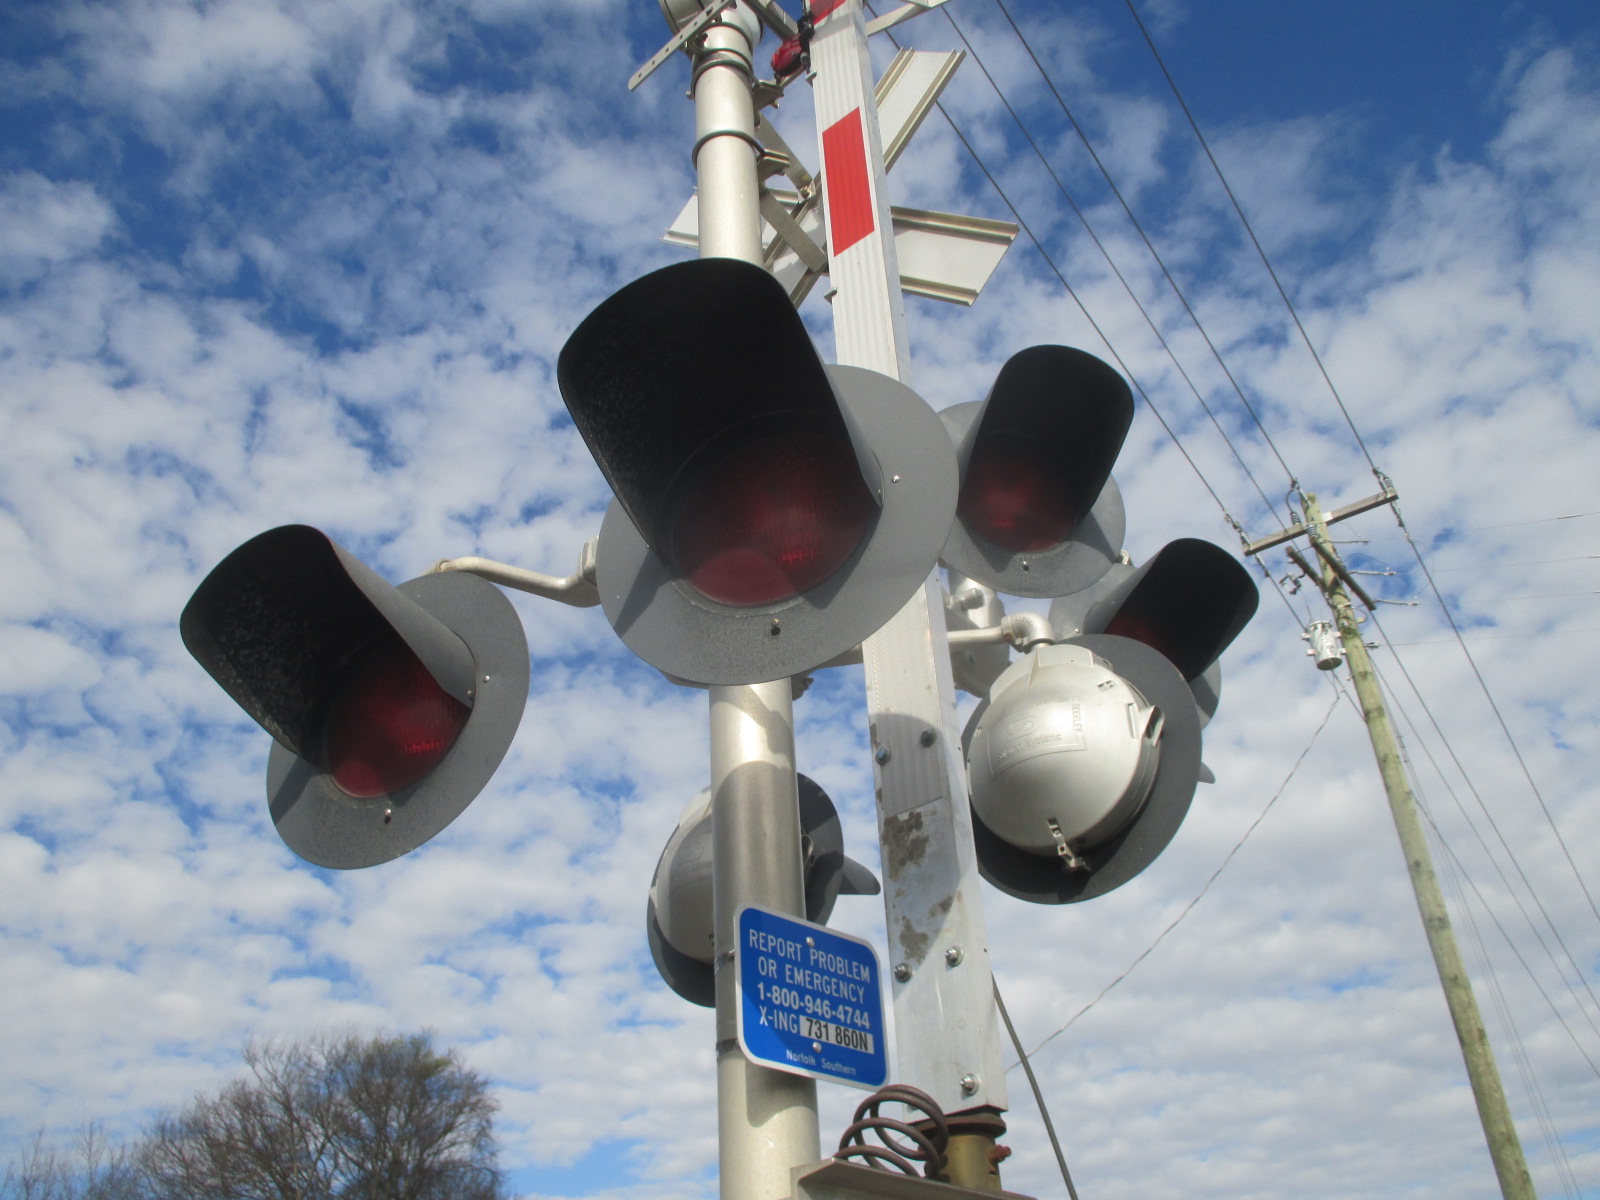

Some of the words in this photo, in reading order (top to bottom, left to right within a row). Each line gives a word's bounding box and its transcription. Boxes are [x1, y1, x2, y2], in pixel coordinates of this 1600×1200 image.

[750, 929, 802, 962] REPORT
[810, 948, 870, 983] PROBLEM
[758, 957, 777, 979] OR
[786, 964, 864, 1004] EMERGENCY
[758, 982, 870, 1029] 1-800-946-4744
[759, 1005, 798, 1034] X-ING
[806, 1018, 829, 1041] 731
[835, 1026, 868, 1051] 860N
[786, 1050, 816, 1066] Norfolk
[822, 1058, 857, 1075] Southern
